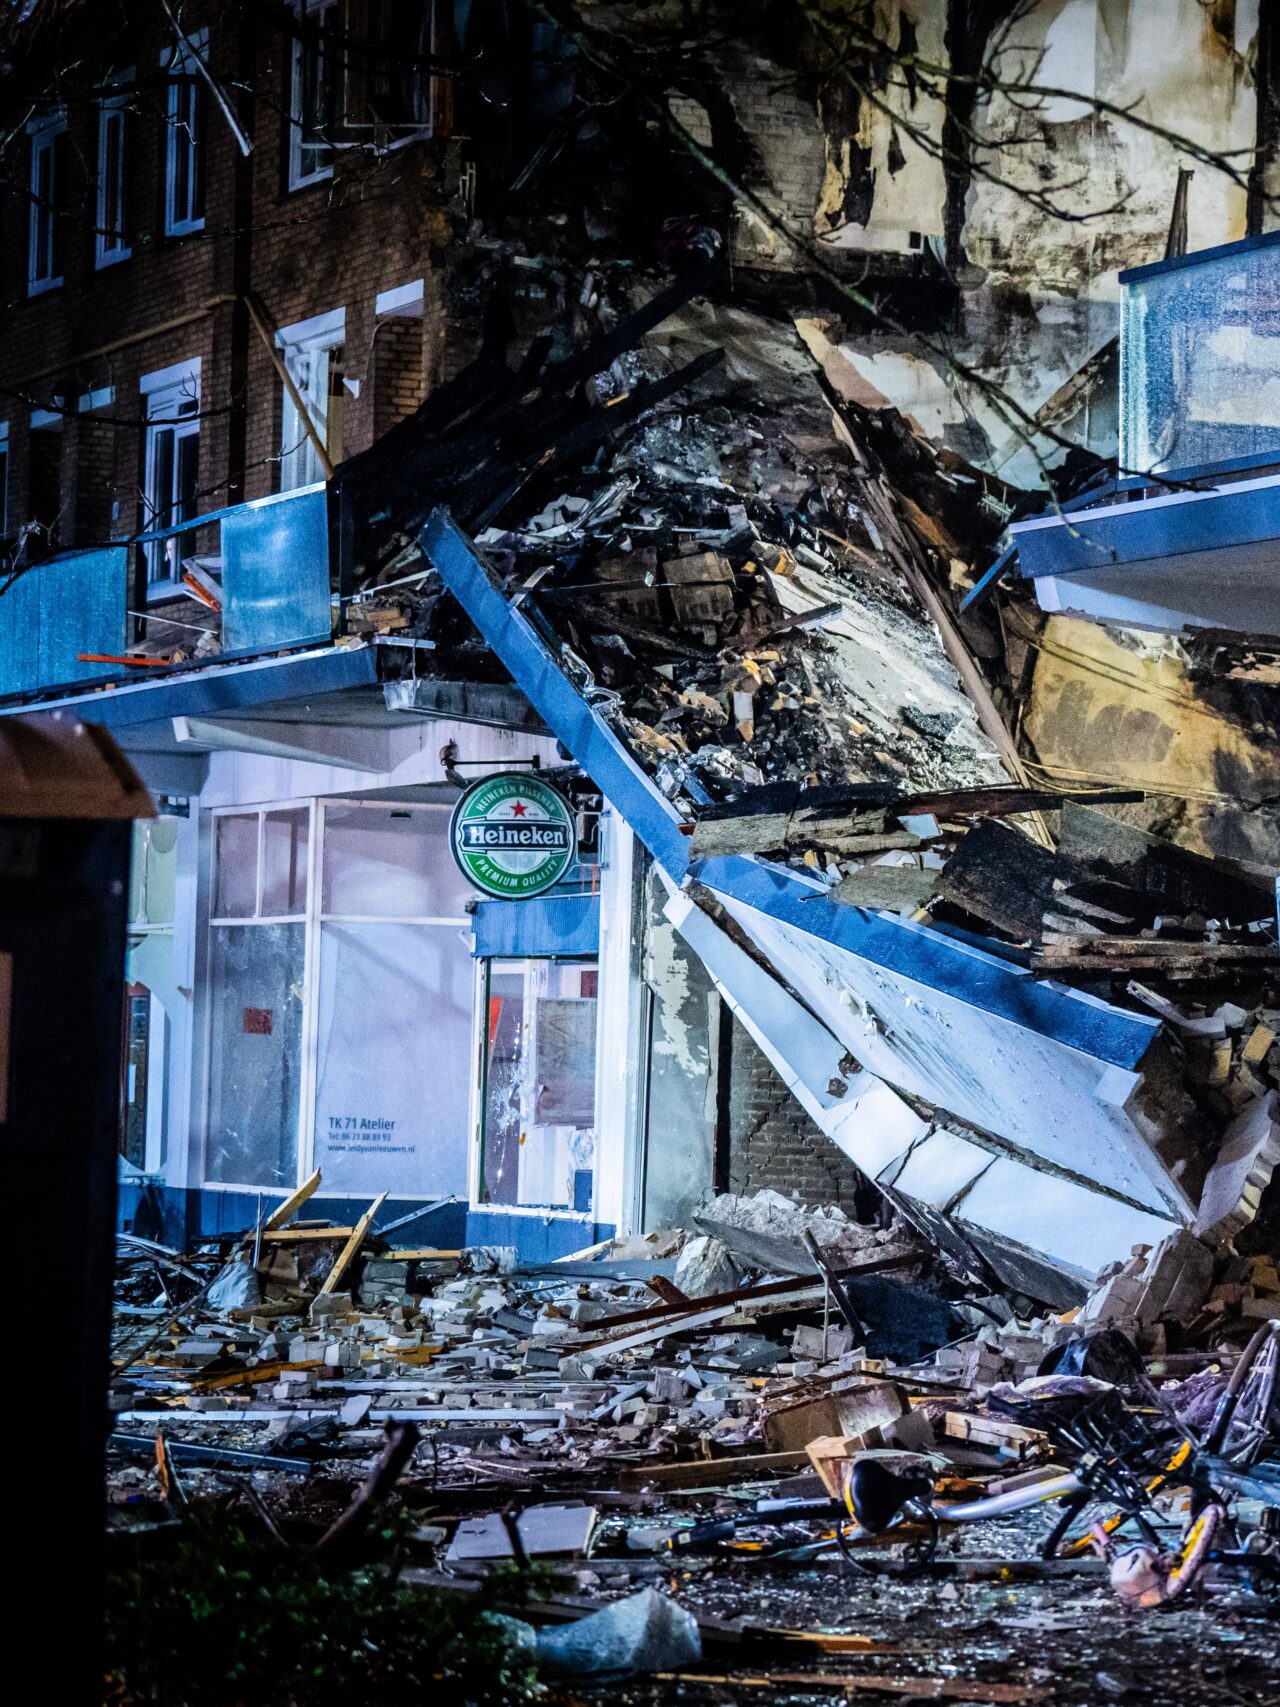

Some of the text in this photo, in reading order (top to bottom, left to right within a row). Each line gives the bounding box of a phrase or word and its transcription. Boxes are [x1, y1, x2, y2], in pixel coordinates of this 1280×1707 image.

[476, 785, 517, 812] HEINEKEN
[469, 826, 565, 845] Heineken
[476, 860, 518, 887] PREMIUM
[522, 859, 558, 887] QUALITY
[328, 1117, 395, 1130] TK 71 Atelier
